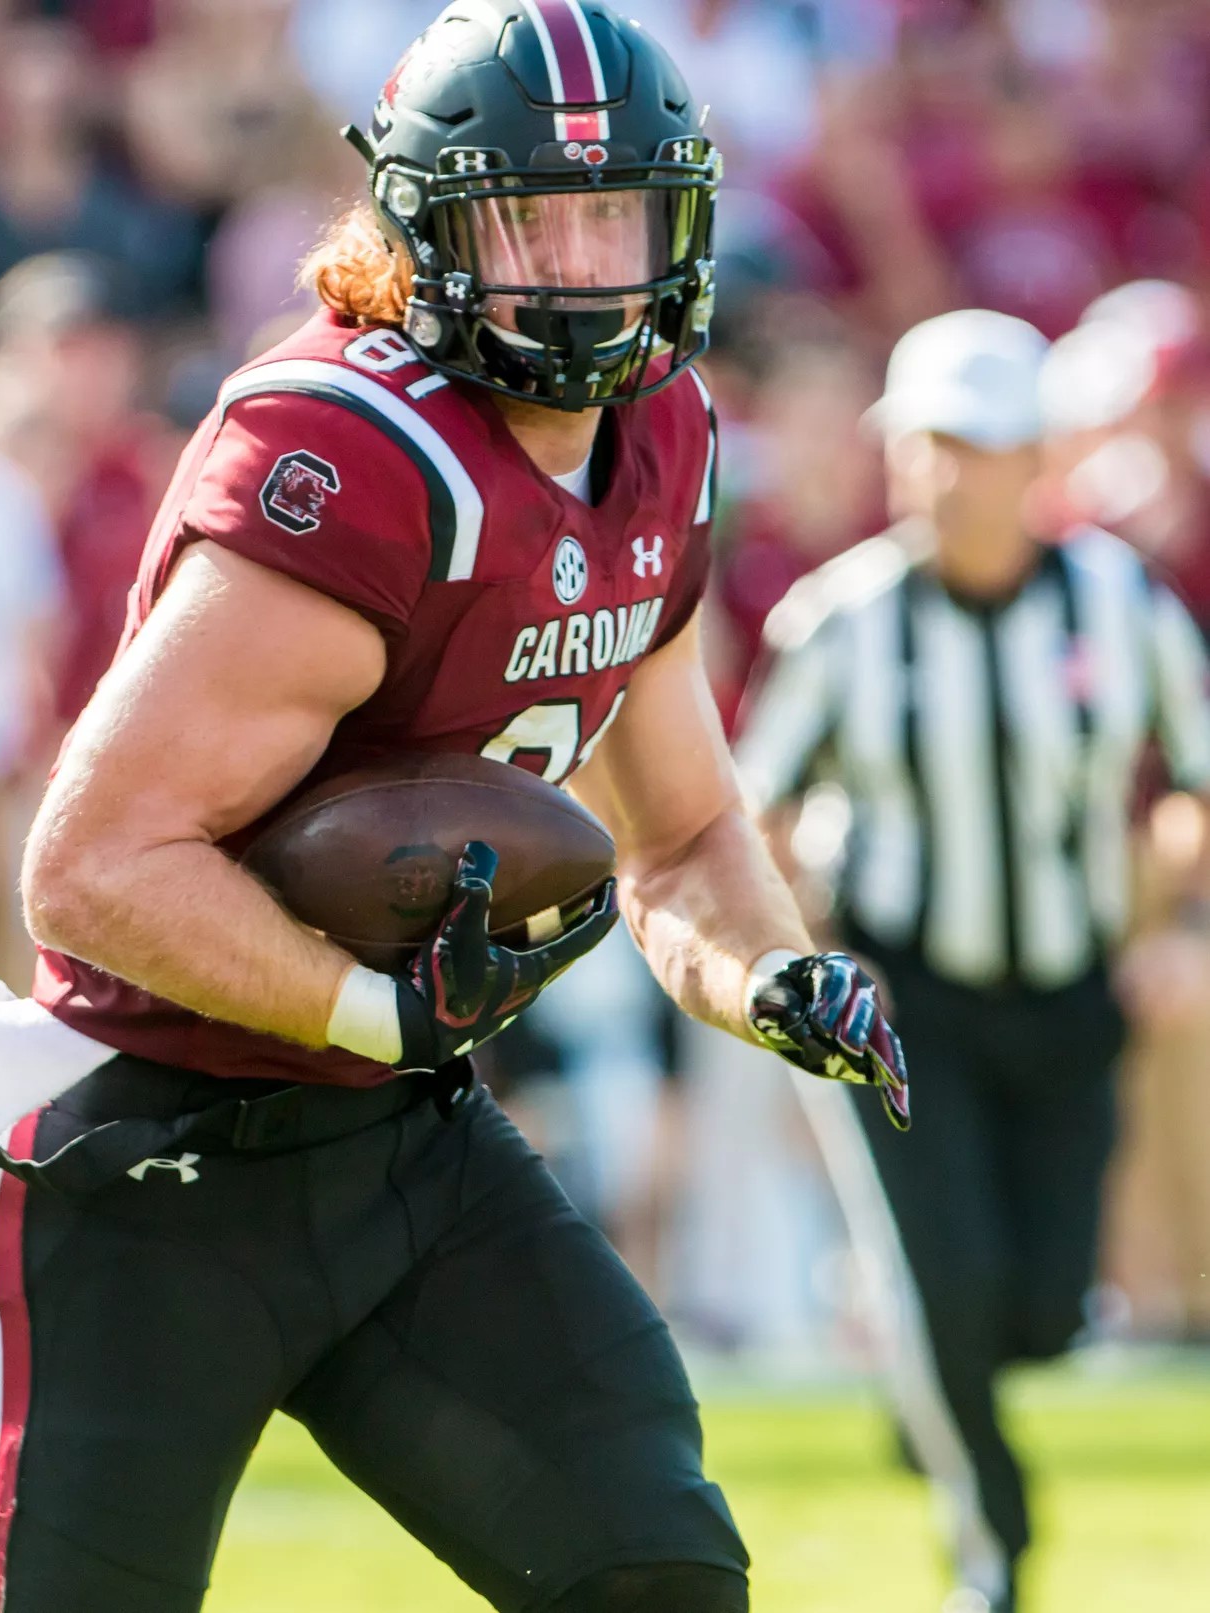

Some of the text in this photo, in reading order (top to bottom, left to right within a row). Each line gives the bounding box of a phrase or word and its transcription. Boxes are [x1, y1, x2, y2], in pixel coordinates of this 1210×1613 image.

[343, 327, 450, 401] 81
[554, 538, 587, 603] SEC
[503, 597, 664, 683] CAROLINA
